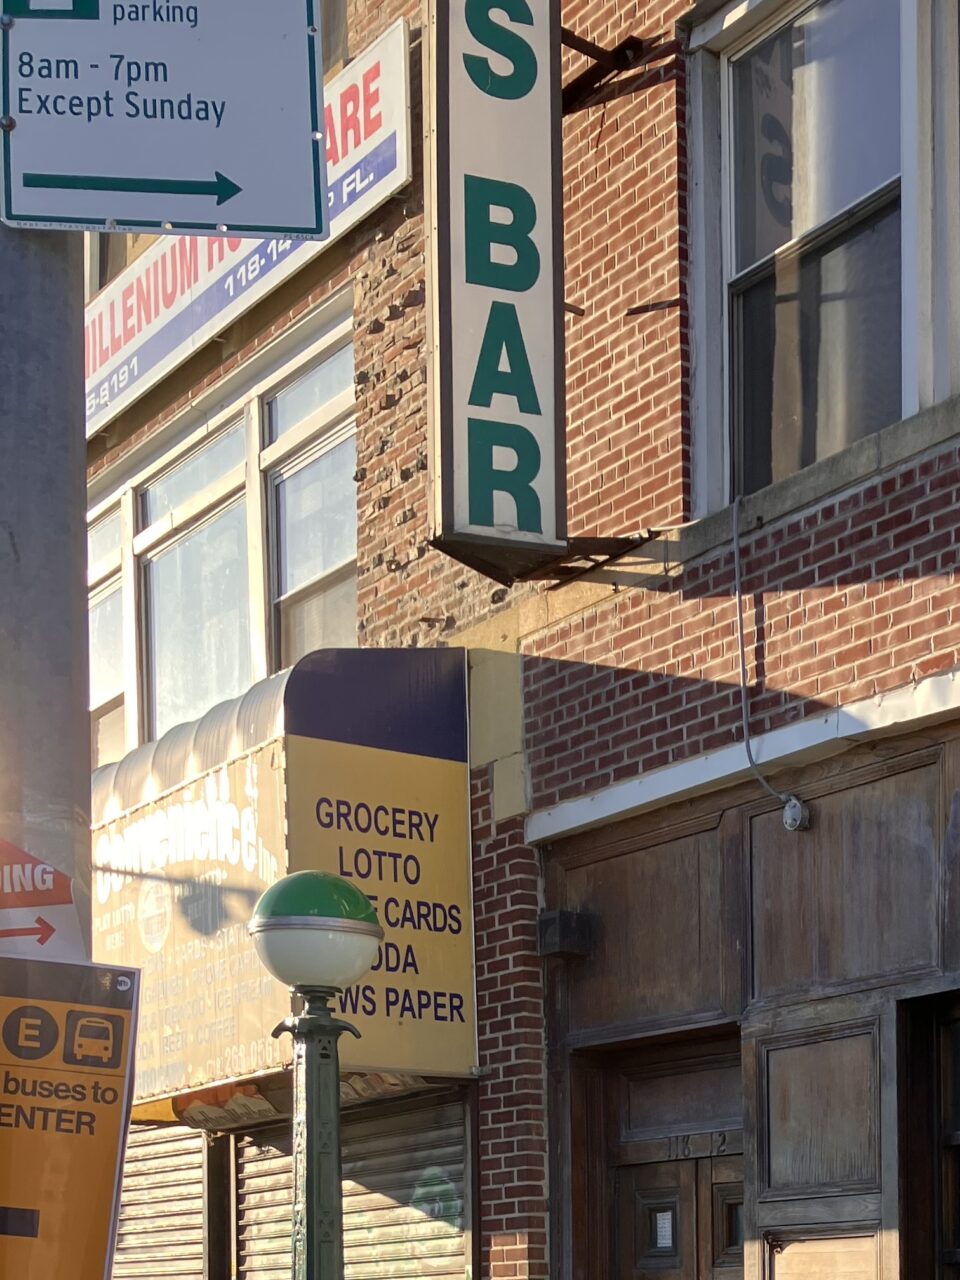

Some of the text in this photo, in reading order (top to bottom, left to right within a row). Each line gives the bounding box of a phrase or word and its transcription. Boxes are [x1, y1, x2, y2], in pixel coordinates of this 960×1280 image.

[113, 1, 199, 28] parking
[18, 52, 79, 80] 8am
[110, 54, 168, 87] 7pm
[18, 88, 226, 128] Except Sunday
[463, 173, 543, 535] BAR
[315, 797, 439, 843] GROCERY
[338, 846, 421, 885] LOTTO
[384, 897, 463, 935] CARDS
[370, 942, 420, 975] DA
[328, 984, 466, 1023] WS PAPER
[18, 1017, 42, 1048] E
[4, 1071, 119, 1105] buses to
